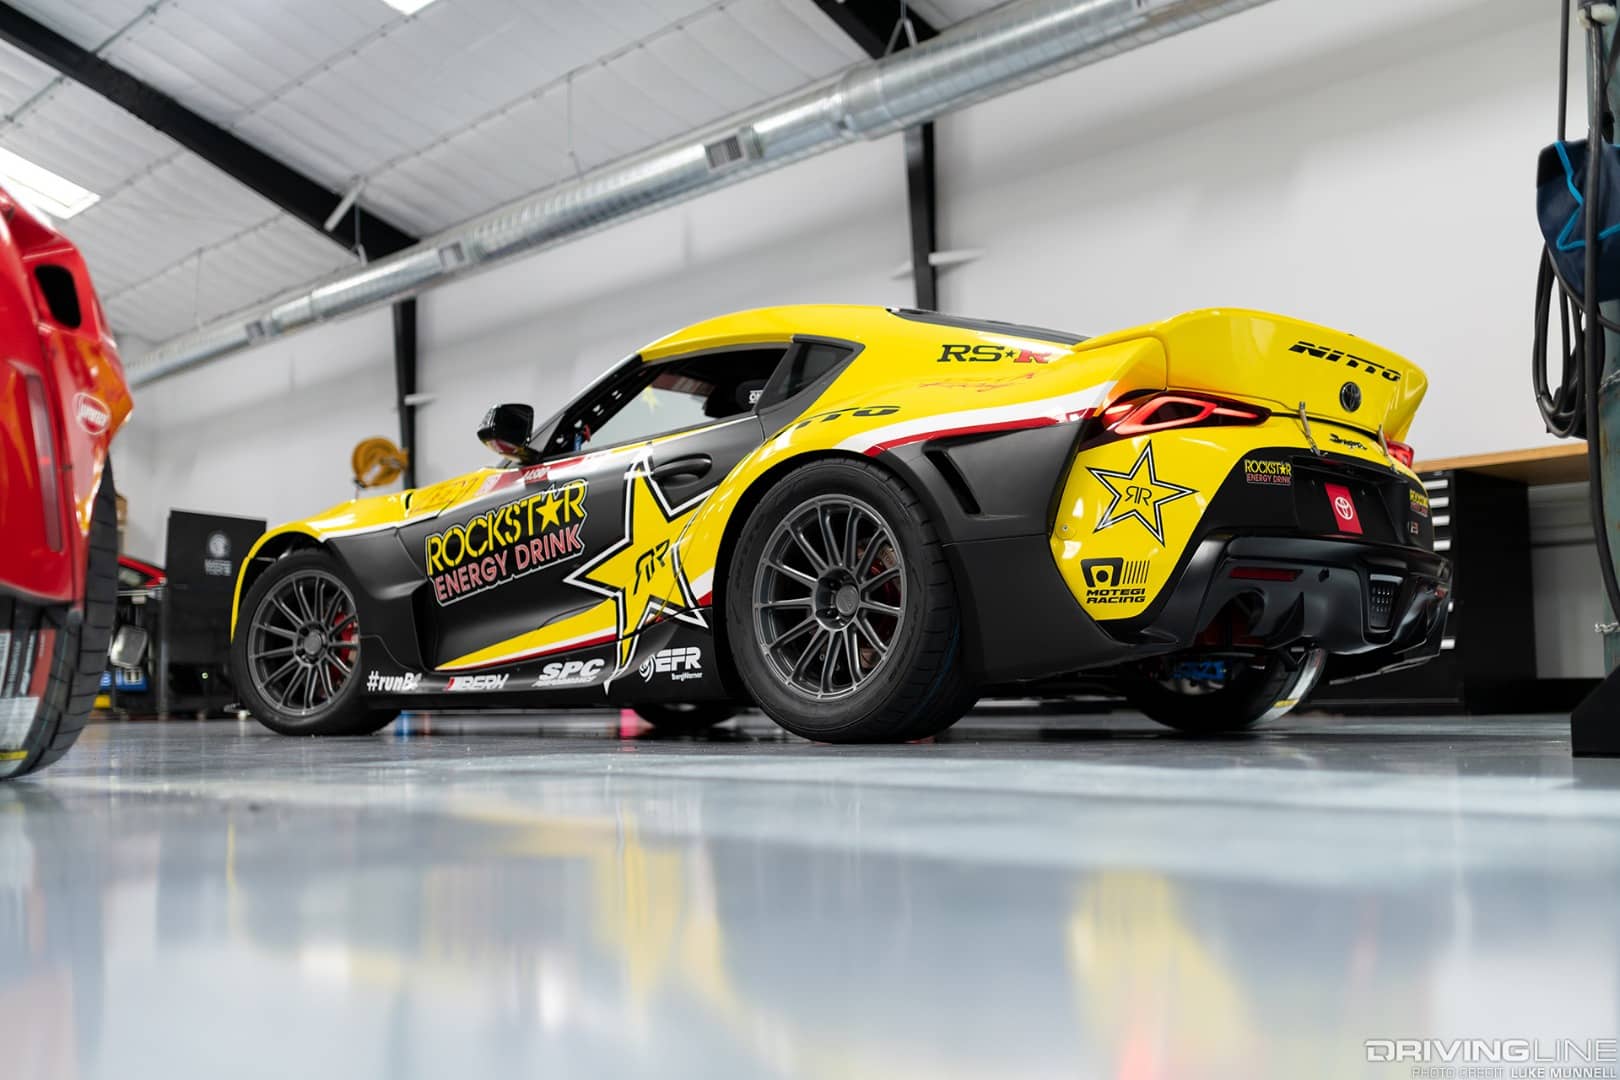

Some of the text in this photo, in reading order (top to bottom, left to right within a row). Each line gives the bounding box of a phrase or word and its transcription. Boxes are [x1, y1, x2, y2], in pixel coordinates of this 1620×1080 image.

[1289, 341, 1402, 382] NITTO
[434, 523, 581, 601] ENERGY DRINK
[1086, 588, 1146, 596] MOTEGI
[1086, 595, 1146, 604] RACING
[538, 658, 605, 681] SPC
[656, 646, 702, 673] EFR
